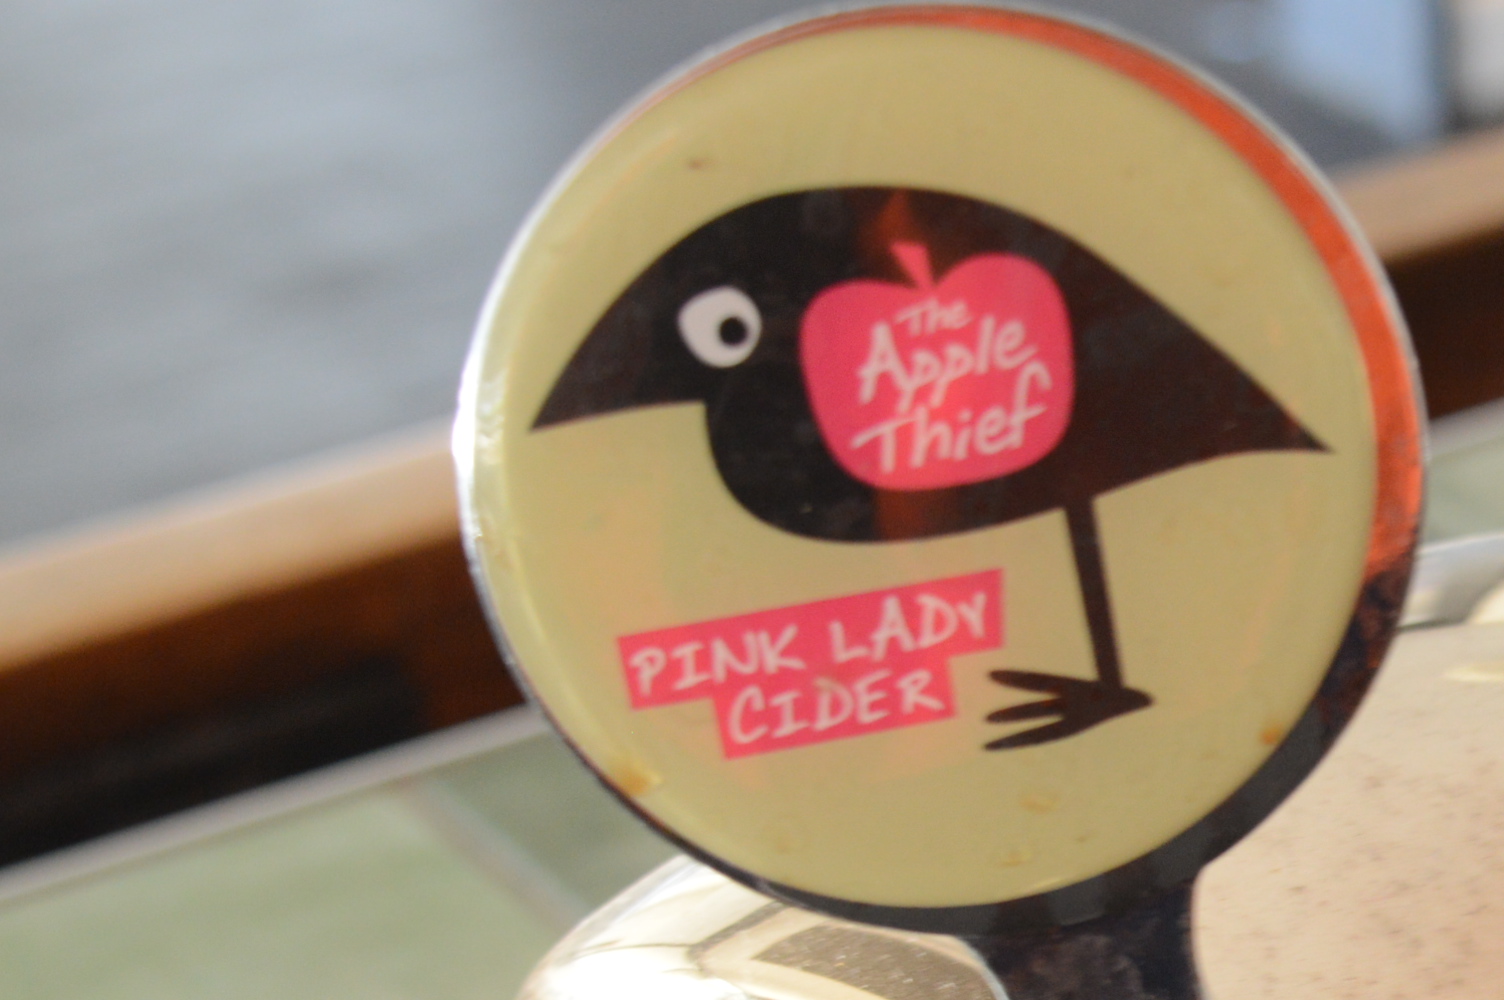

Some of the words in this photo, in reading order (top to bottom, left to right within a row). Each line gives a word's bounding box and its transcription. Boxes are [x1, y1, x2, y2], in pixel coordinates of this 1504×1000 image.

[857, 315, 1038, 416] Apple
[896, 298, 973, 337] The
[851, 360, 1051, 474] Thief
[629, 624, 807, 696] PINK
[828, 592, 987, 664] LADY
[728, 668, 945, 744] CIDER
